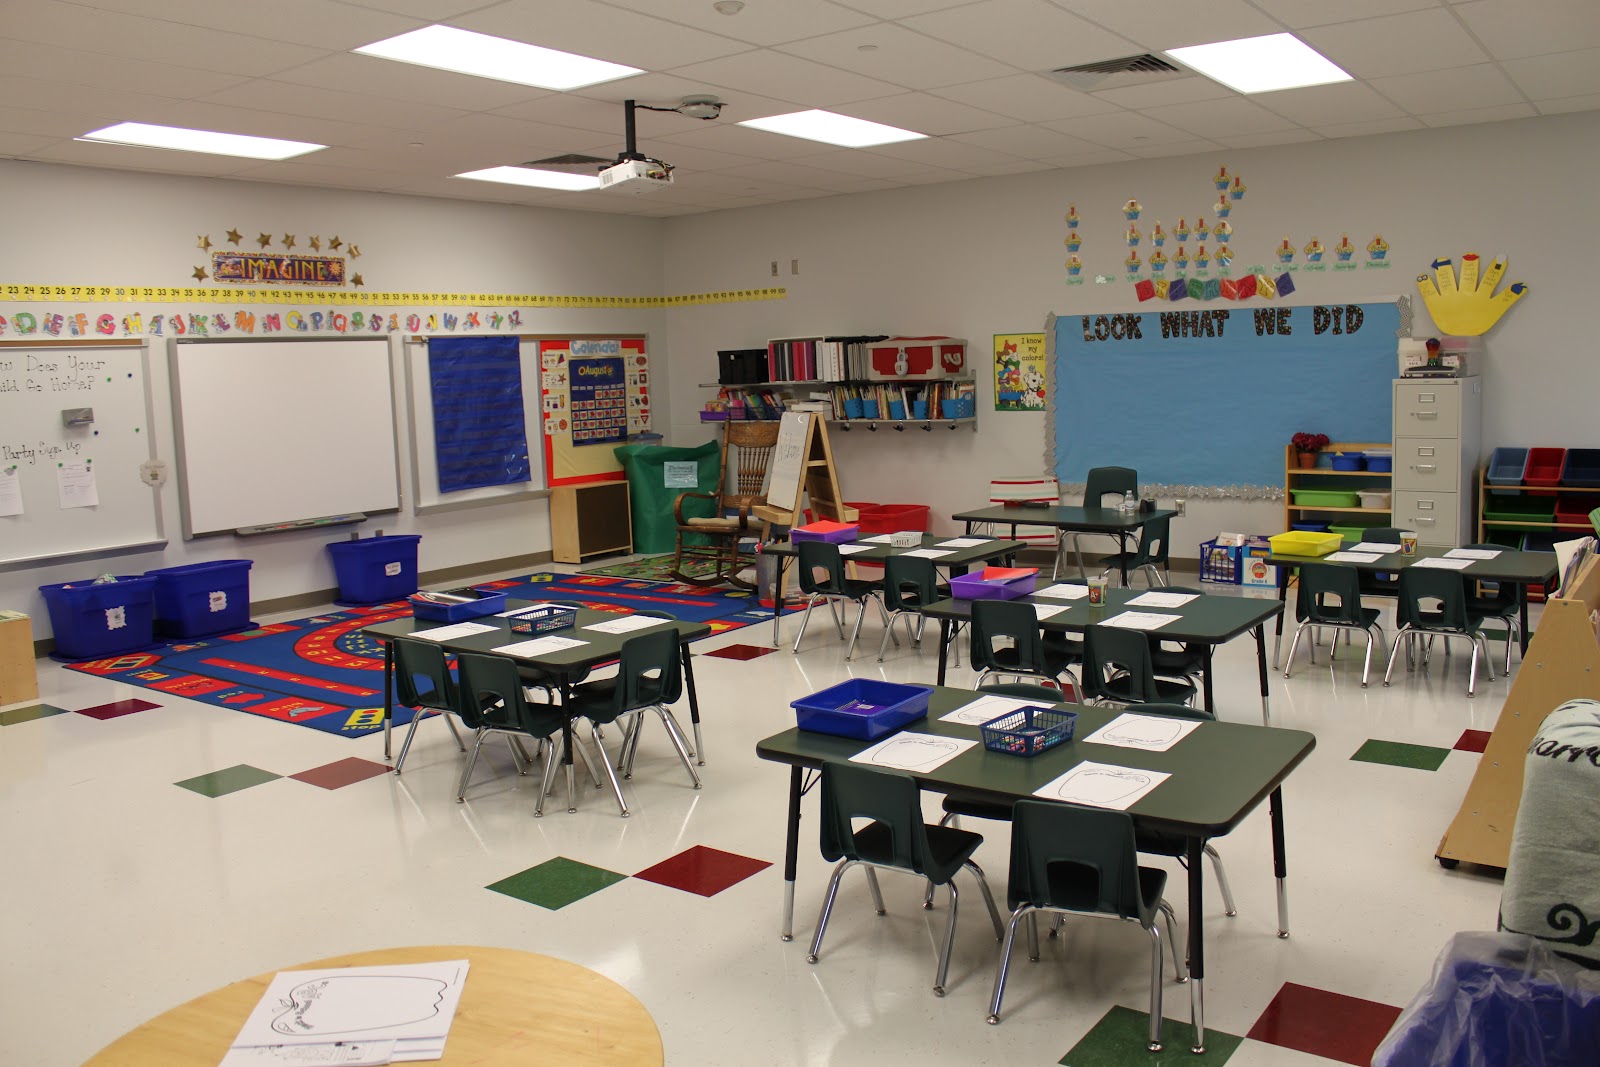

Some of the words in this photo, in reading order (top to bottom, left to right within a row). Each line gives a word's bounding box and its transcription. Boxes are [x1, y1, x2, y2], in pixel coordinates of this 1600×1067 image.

[240, 258, 326, 280] IMAGINE
[1082, 313, 1142, 342] LOOK
[1160, 310, 1230, 338] WHAT
[1254, 308, 1292, 336] WE
[1314, 304, 1364, 335] DID
[570, 340, 619, 354] Calendar
[27, 355, 58, 371] Does
[68, 356, 106, 382] Your
[585, 366, 608, 378] August
[26, 379, 42, 392] Go
[50, 376, 95, 392] Home?
[2, 445, 36, 465] Party
[39, 441, 62, 459] Sign
[66, 442, 81, 454] Up
[1090, 591, 1098, 599] A+
